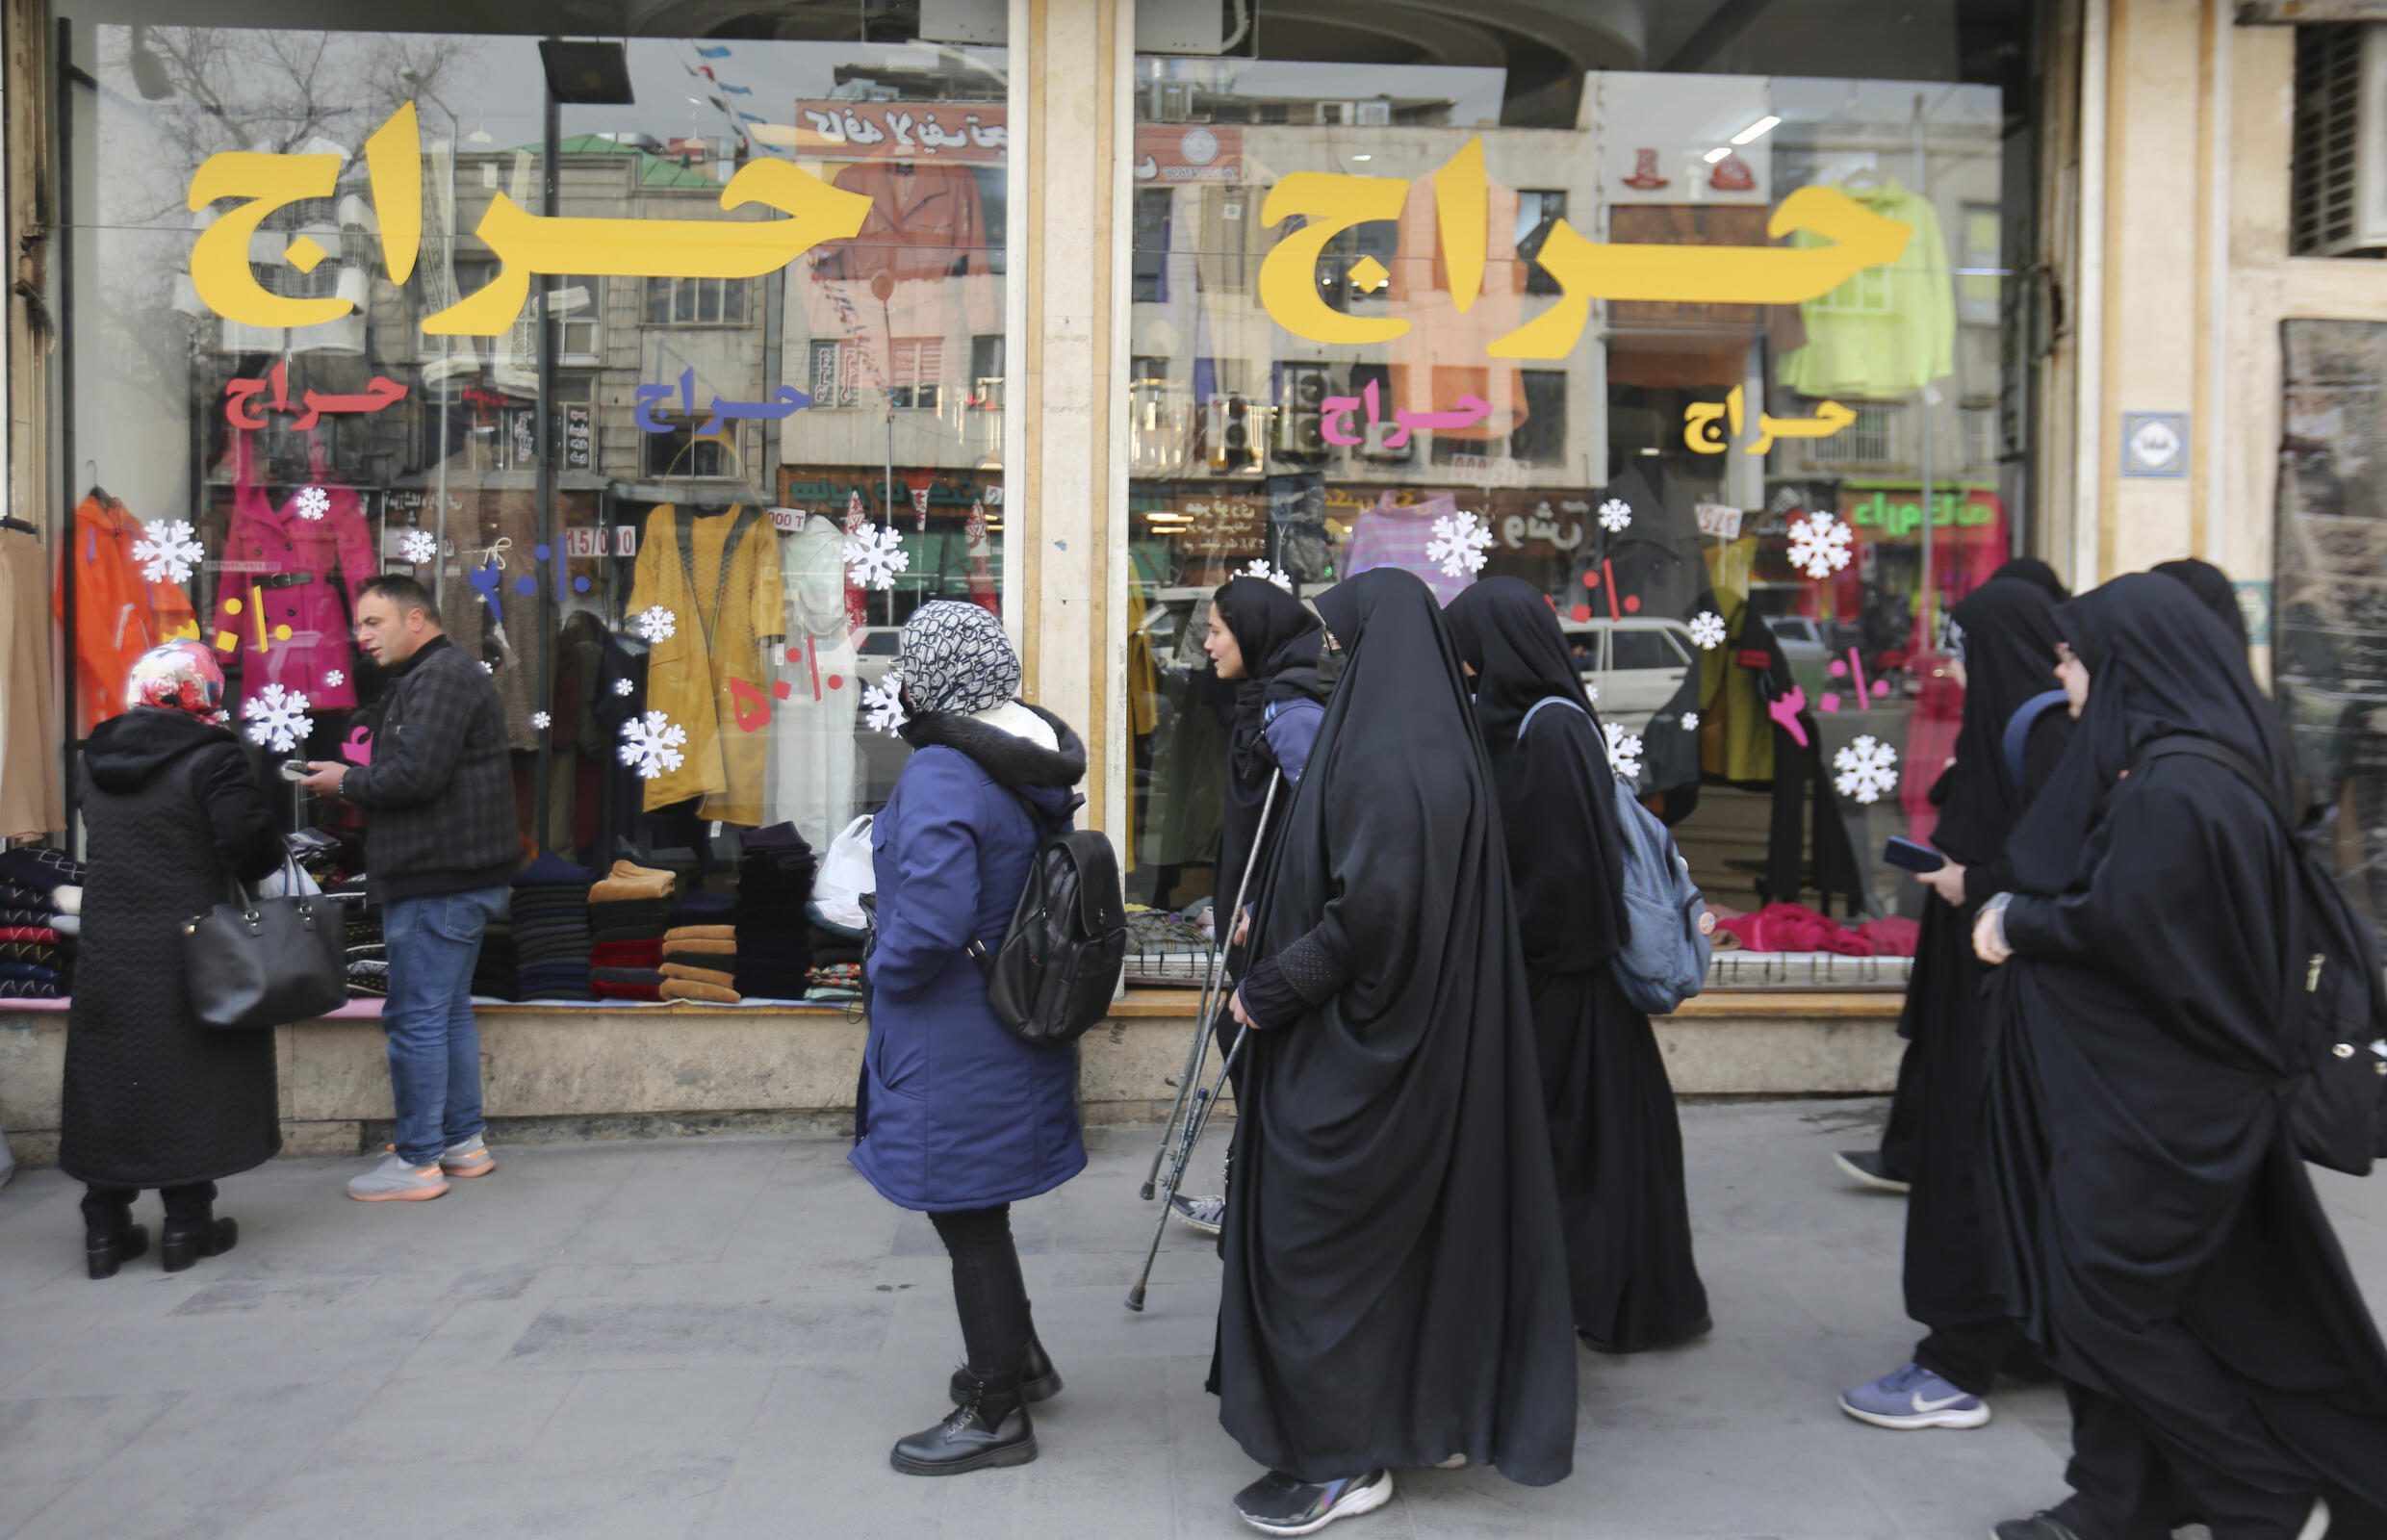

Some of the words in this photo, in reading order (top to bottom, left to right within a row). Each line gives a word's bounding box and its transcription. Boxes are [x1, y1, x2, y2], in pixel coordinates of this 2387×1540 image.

[188, 101, 875, 337] حراج
[1258, 135, 1915, 360] حراج
[226, 359, 408, 431] حراج
[634, 368, 812, 435] حراج
[1321, 377, 1494, 449] حراج
[1684, 385, 1857, 454] حراج
